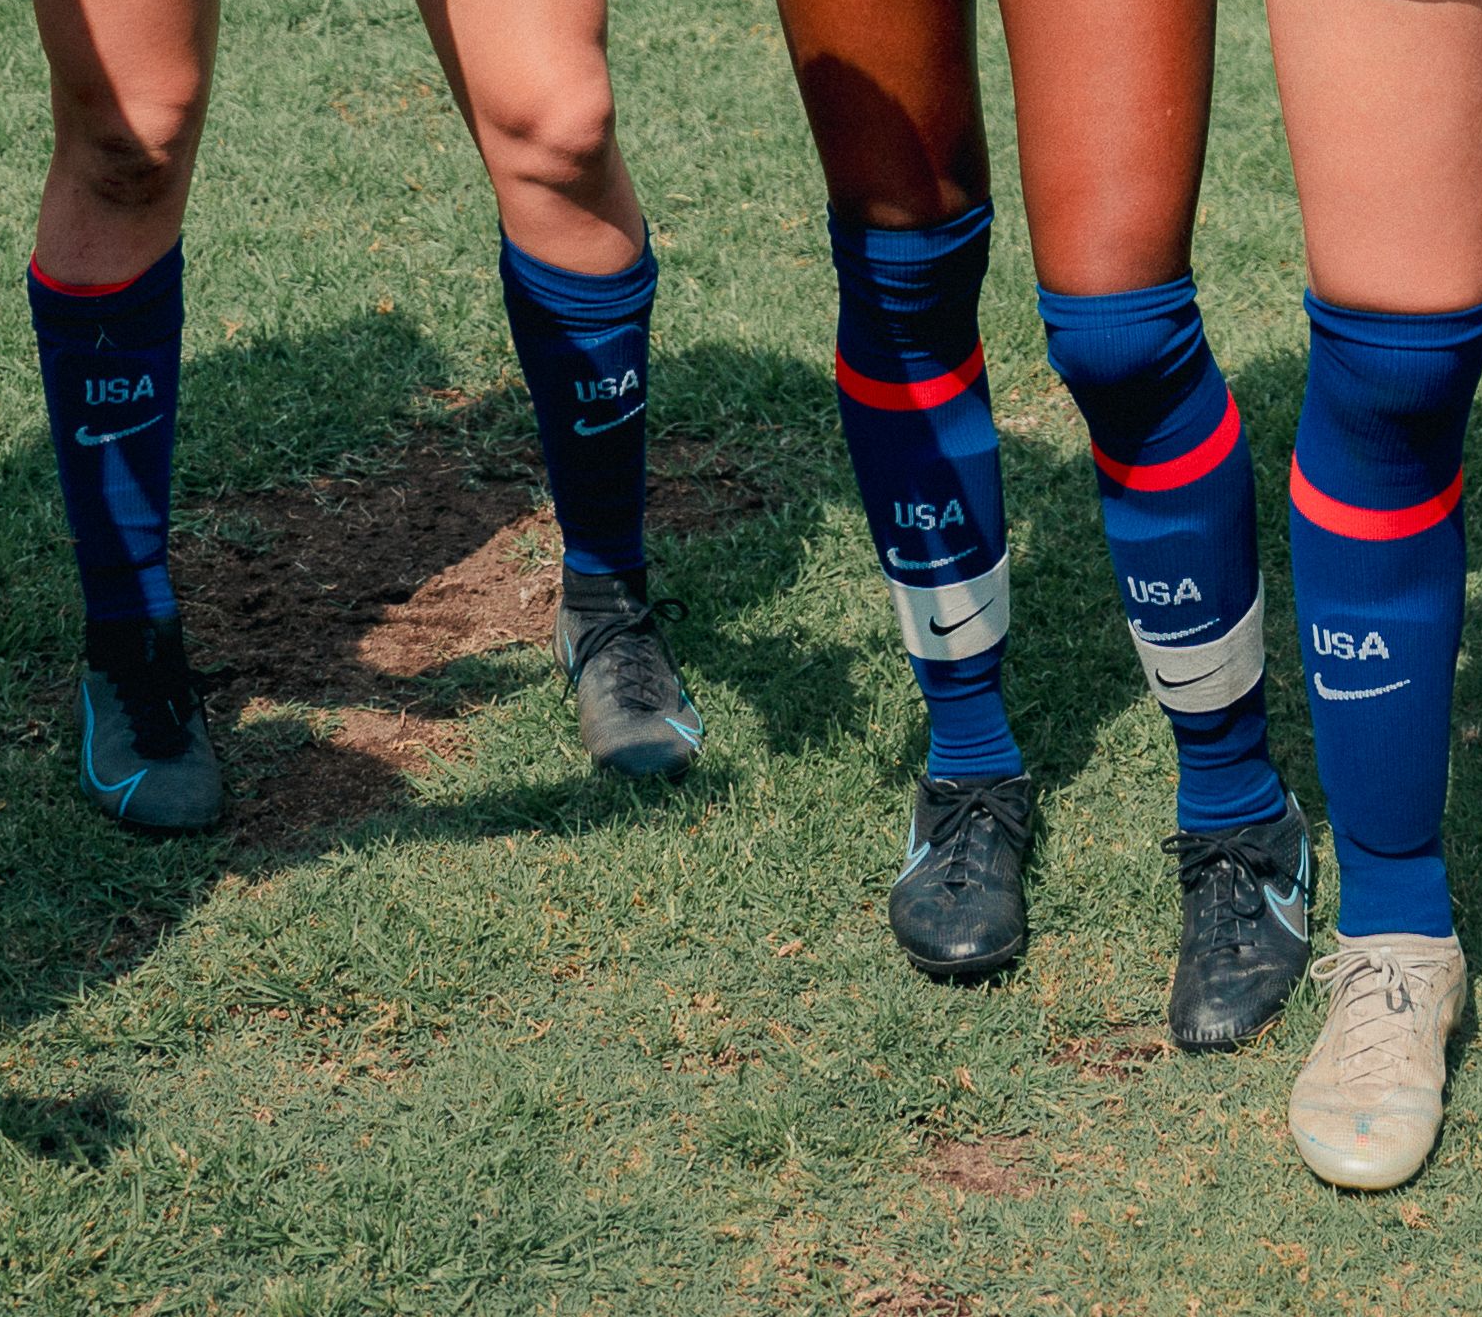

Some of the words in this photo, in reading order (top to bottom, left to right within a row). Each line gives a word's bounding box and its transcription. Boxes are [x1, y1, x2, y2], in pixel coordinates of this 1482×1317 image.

[86, 374, 155, 406] USA
[575, 369, 639, 402] USA
[894, 499, 965, 531] USA
[1127, 576, 1203, 606] USA
[1312, 623, 1390, 660] USA
